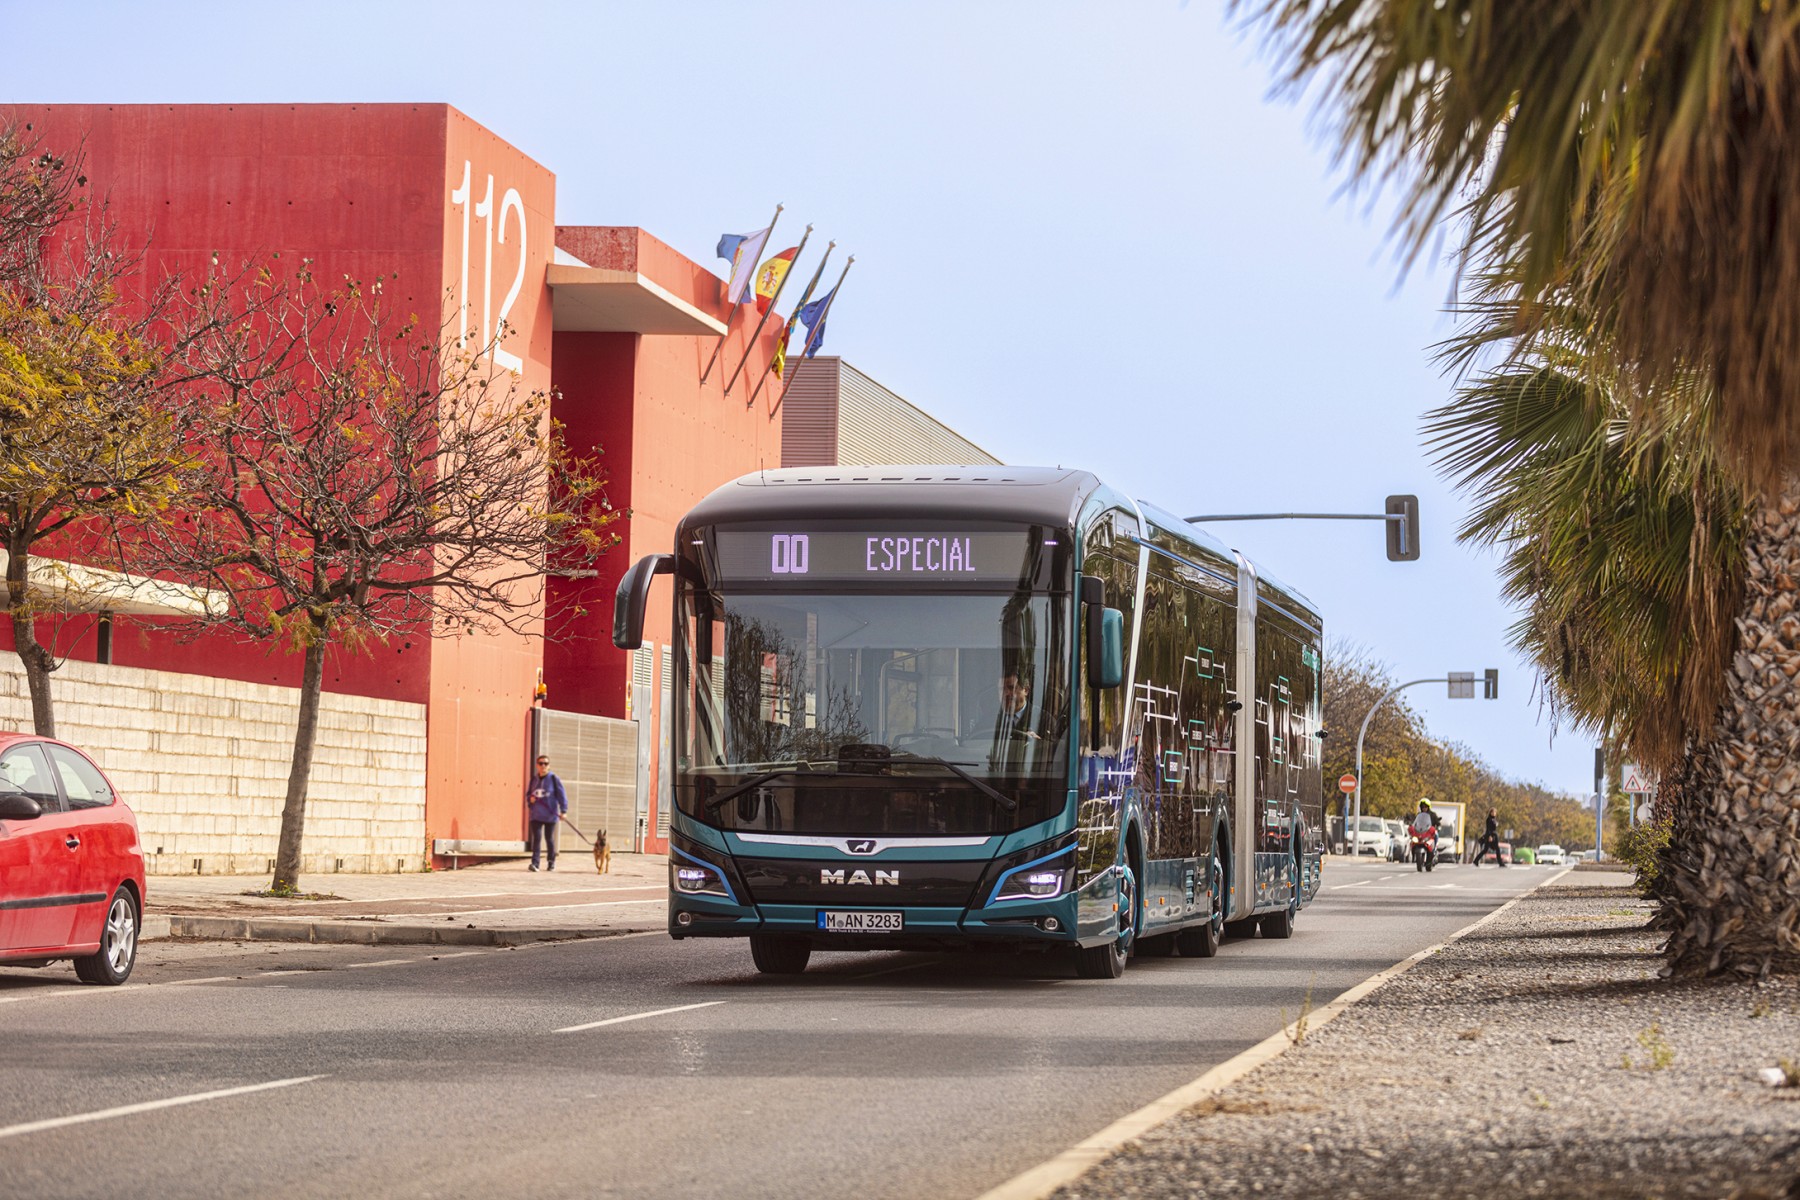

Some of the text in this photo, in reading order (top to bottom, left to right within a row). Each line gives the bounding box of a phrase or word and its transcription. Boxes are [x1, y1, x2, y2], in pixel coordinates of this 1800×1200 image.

[452, 160, 527, 375] 112
[772, 534, 976, 574] 00 ESPECIAL
[821, 869, 899, 886] MAN
[866, 914, 901, 929] 3283
